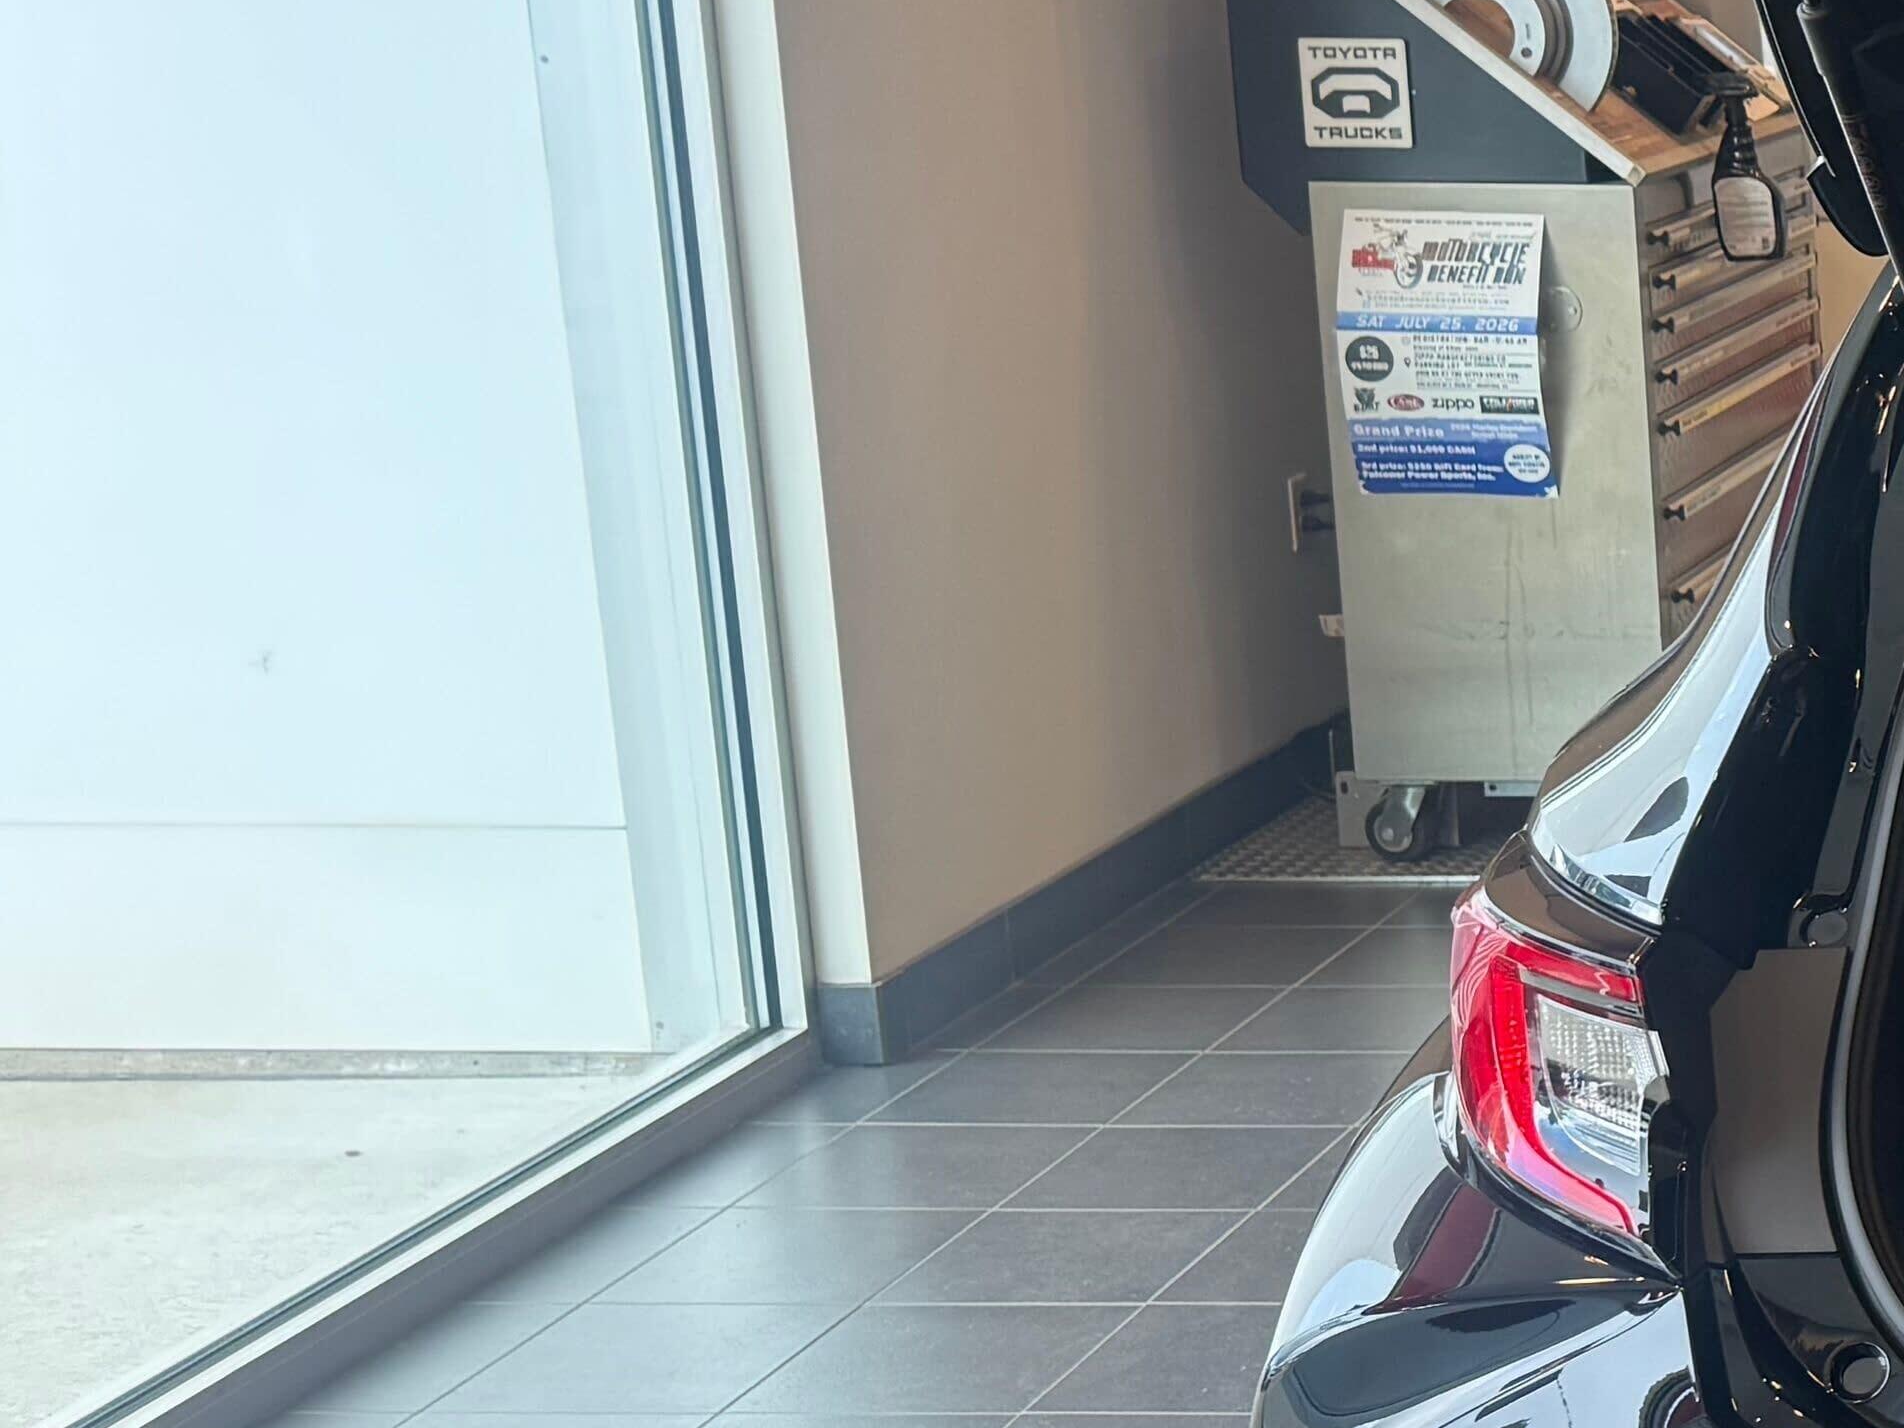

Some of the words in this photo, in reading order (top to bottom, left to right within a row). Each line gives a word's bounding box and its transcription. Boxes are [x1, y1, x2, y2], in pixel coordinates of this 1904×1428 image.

[1307, 45, 1397, 60] TOYOTA
[1313, 126, 1403, 140] TRUCKS
[1422, 238, 1531, 264] MOTORCYCLE
[1427, 263, 1489, 285] BENEFIT
[1492, 264, 1527, 285] RUN
[1355, 314, 1385, 329] SAT
[1394, 315, 1430, 330] JULY
[1474, 317, 1520, 332] 2026
[1431, 396, 1475, 411] zippo
[1353, 423, 1401, 438] Grand
[1404, 425, 1446, 439] Prize
[1357, 444, 1378, 453] 2nd
